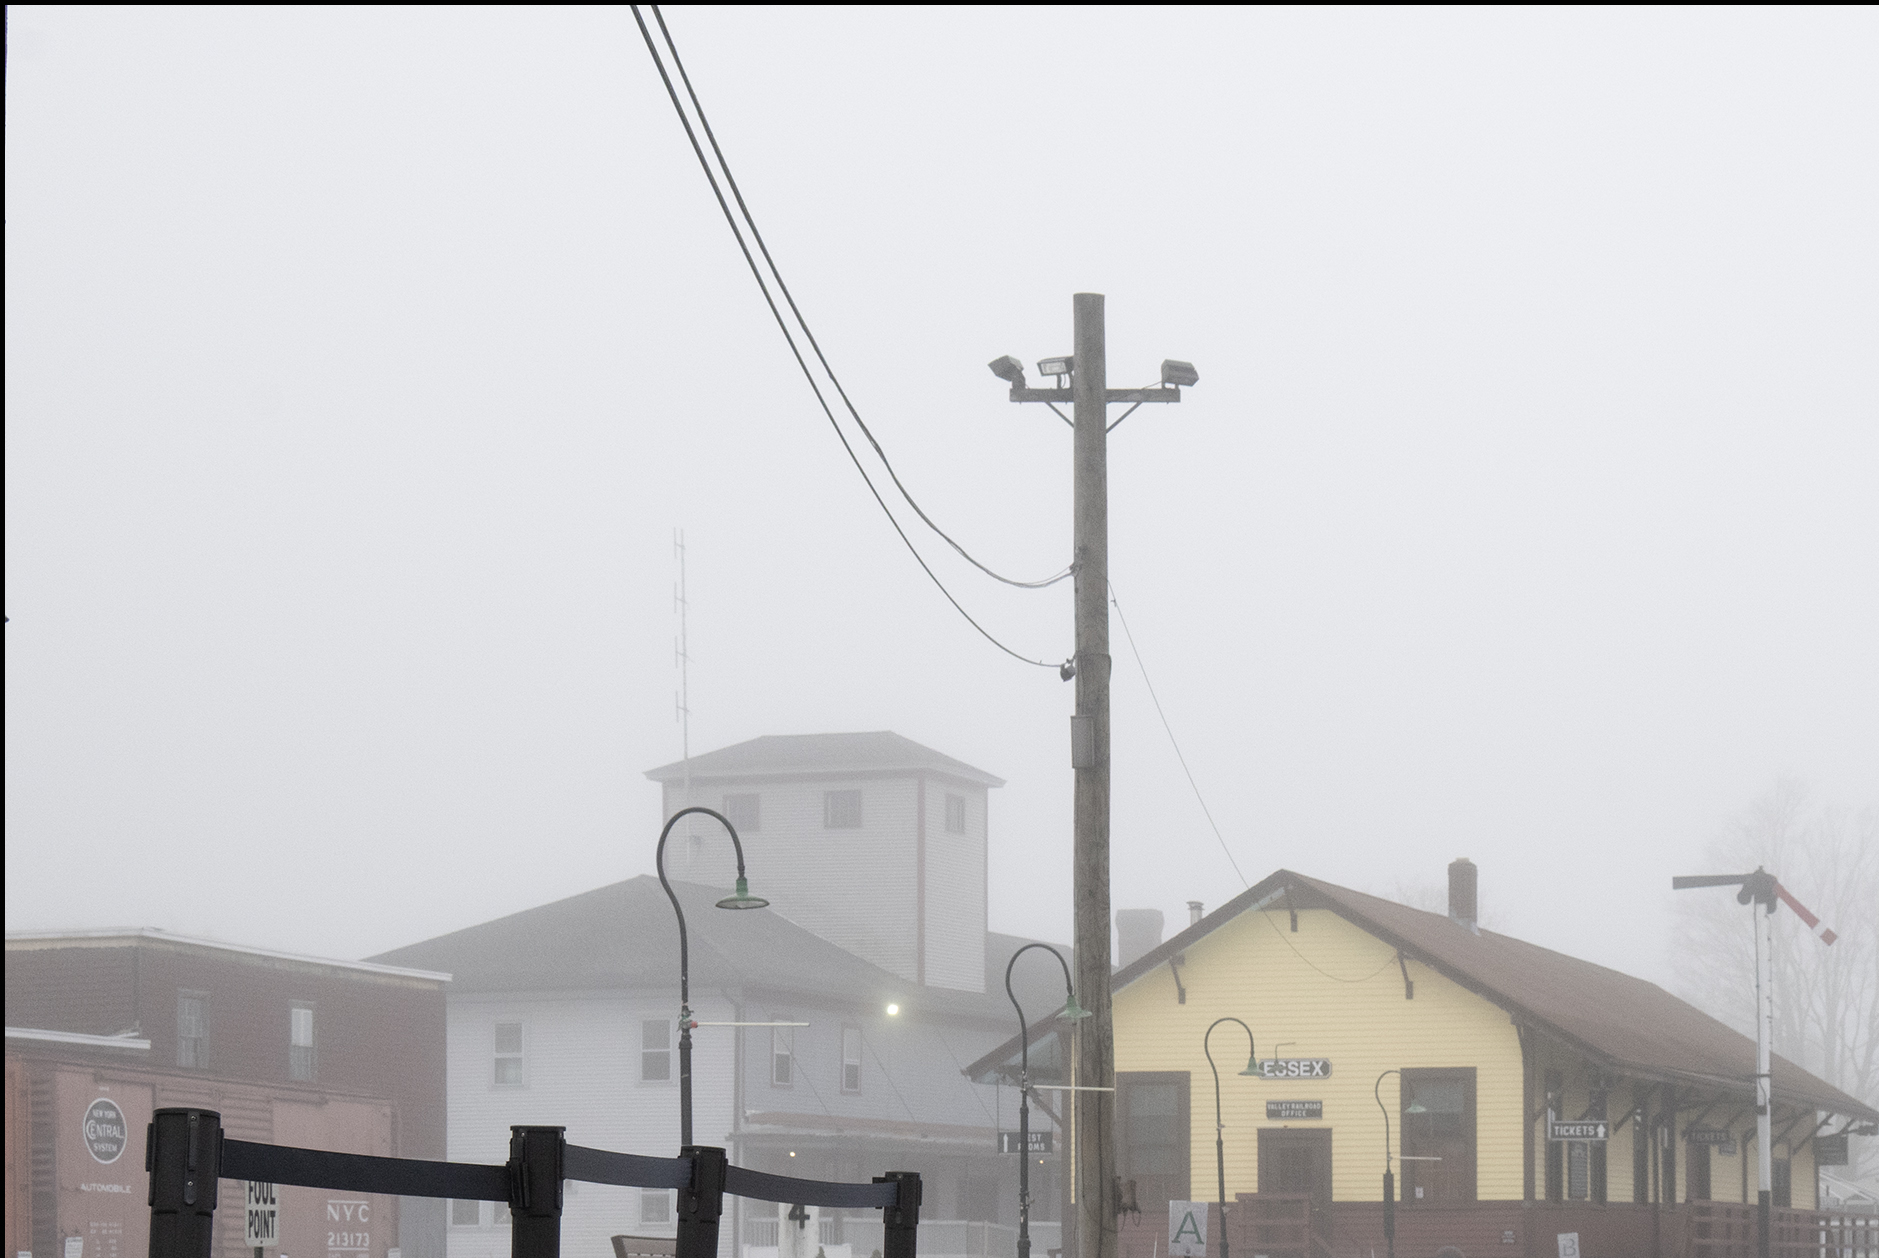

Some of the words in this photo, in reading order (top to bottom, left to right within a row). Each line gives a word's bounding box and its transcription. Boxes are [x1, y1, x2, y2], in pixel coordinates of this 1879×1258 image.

[1263, 1061, 1324, 1076] ESSEX
[93, 1110, 103, 1118] NEW
[104, 1111, 116, 1119] YORK
[87, 1120, 124, 1140] CENTRAL
[1028, 1133, 1041, 1142] EST
[1554, 1125, 1595, 1136] TICKETS
[93, 1143, 117, 1152] SYSTEM
[81, 1183, 132, 1194] AUTOMOBILE
[248, 1181, 276, 1205] FOUL
[327, 1204, 370, 1223] NYC
[248, 1209, 276, 1239] POINT
[1171, 1211, 1205, 1245] A
[327, 1231, 370, 1247] 213173
[1563, 1238, 1577, 1256] B
